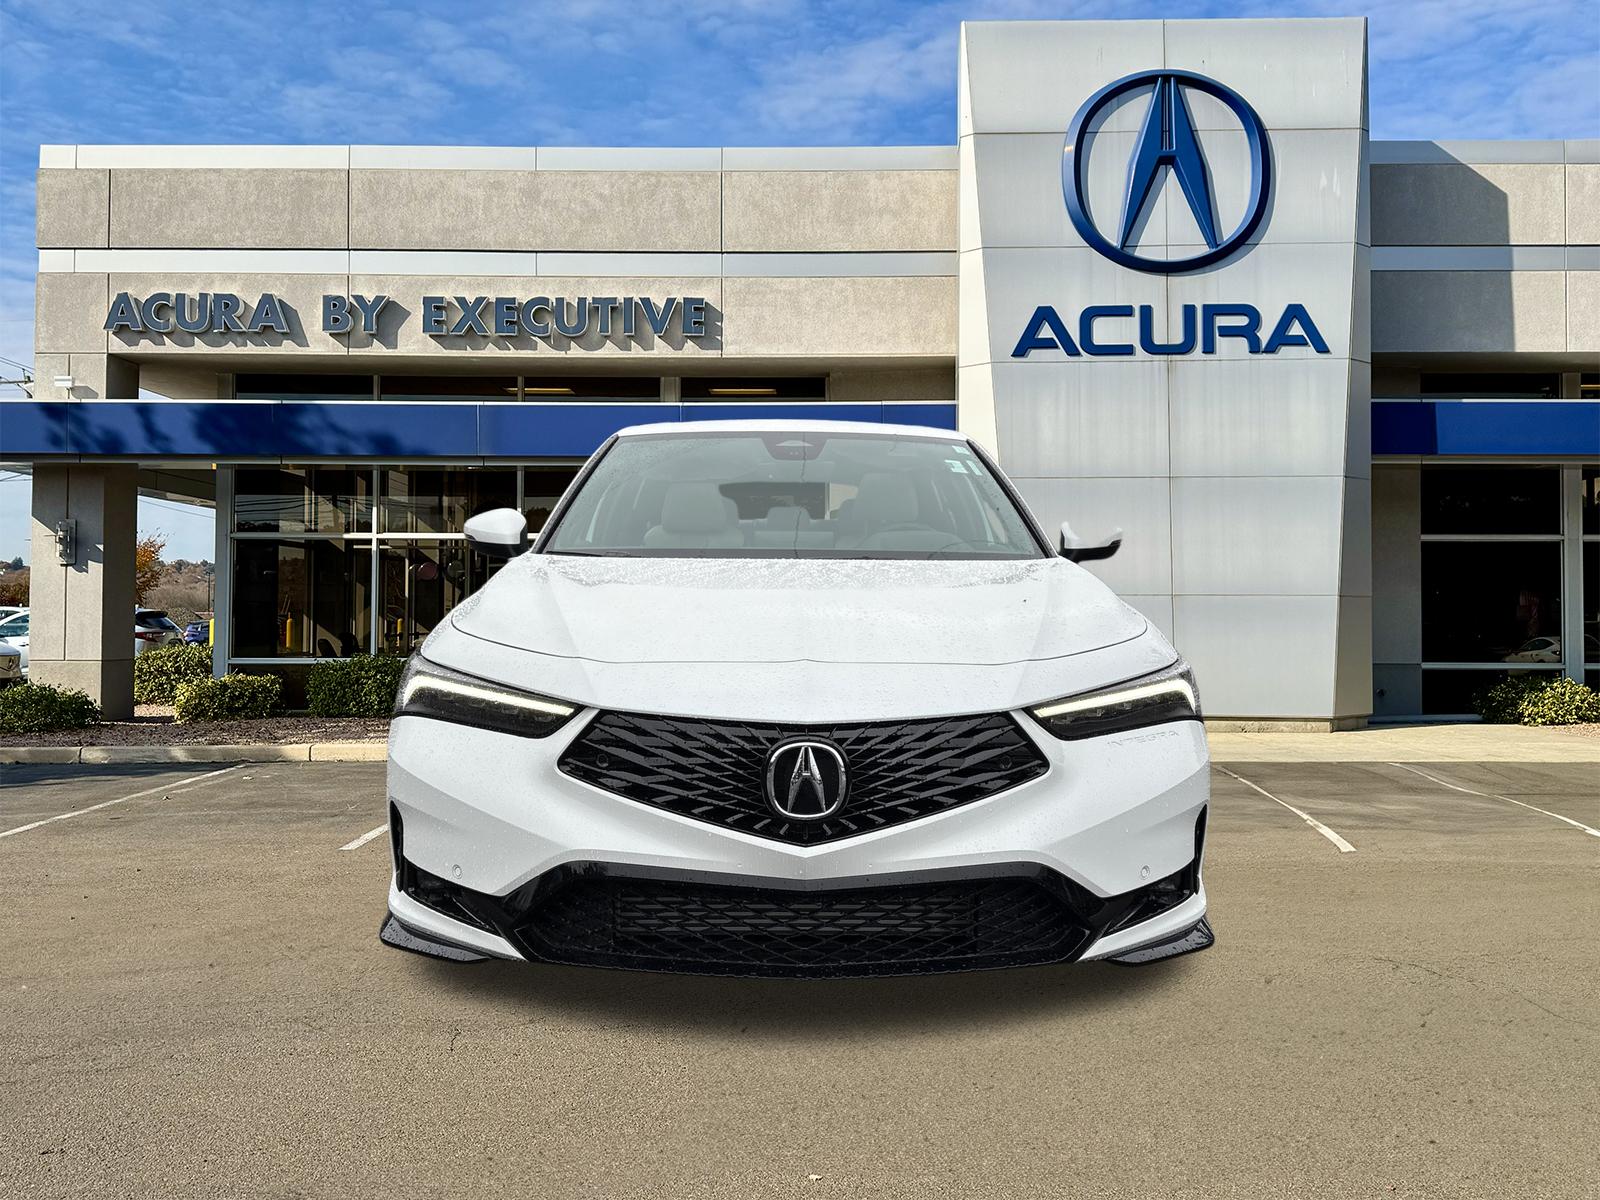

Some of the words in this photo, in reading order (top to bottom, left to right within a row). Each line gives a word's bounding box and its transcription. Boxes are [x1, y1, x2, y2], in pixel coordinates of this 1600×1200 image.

[104, 291, 291, 333] ACURA
[322, 293, 392, 335] BY
[422, 295, 708, 337] EXECUTIVE
[1010, 303, 1331, 357] ACURA
